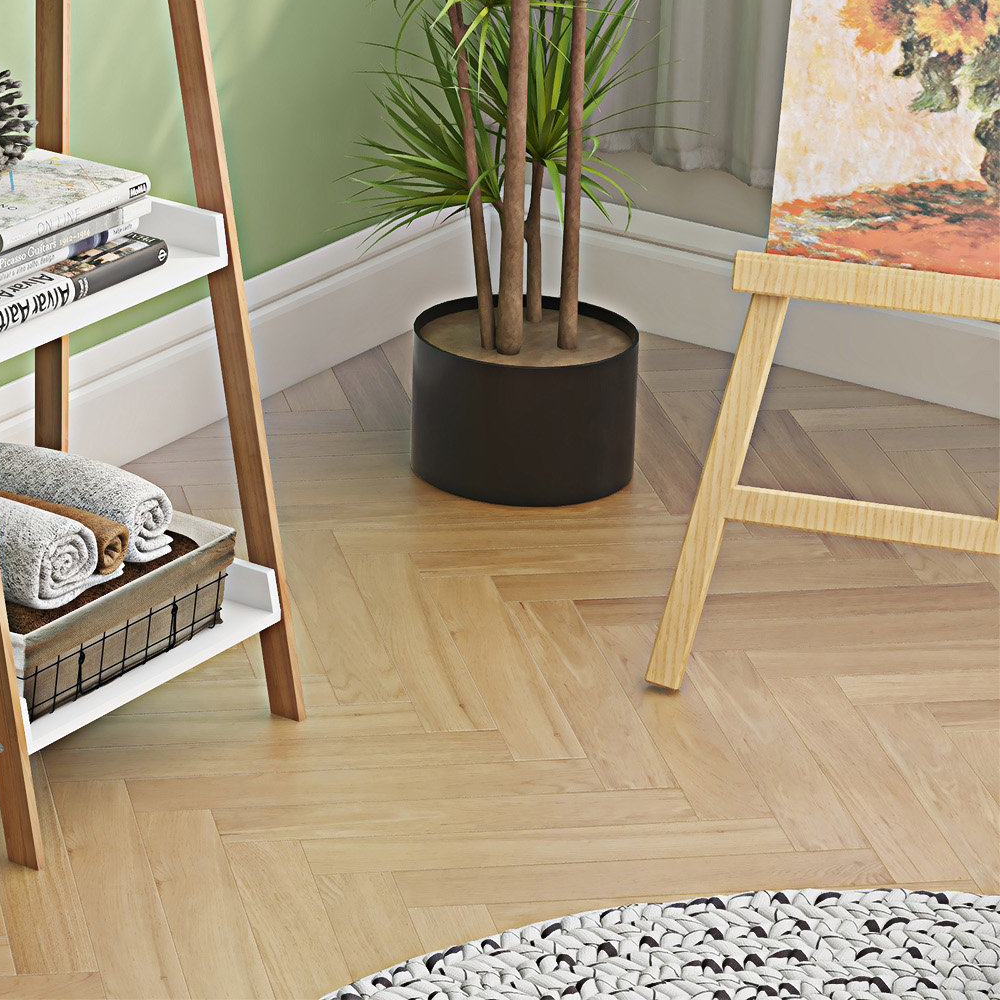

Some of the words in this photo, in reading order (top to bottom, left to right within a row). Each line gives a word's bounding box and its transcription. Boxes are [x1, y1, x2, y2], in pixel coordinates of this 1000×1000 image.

[130, 183, 147, 198] MoMA
[27, 240, 57, 258] Guitars
[7, 273, 55, 294] Alvar
[31, 282, 70, 315] Alvar
